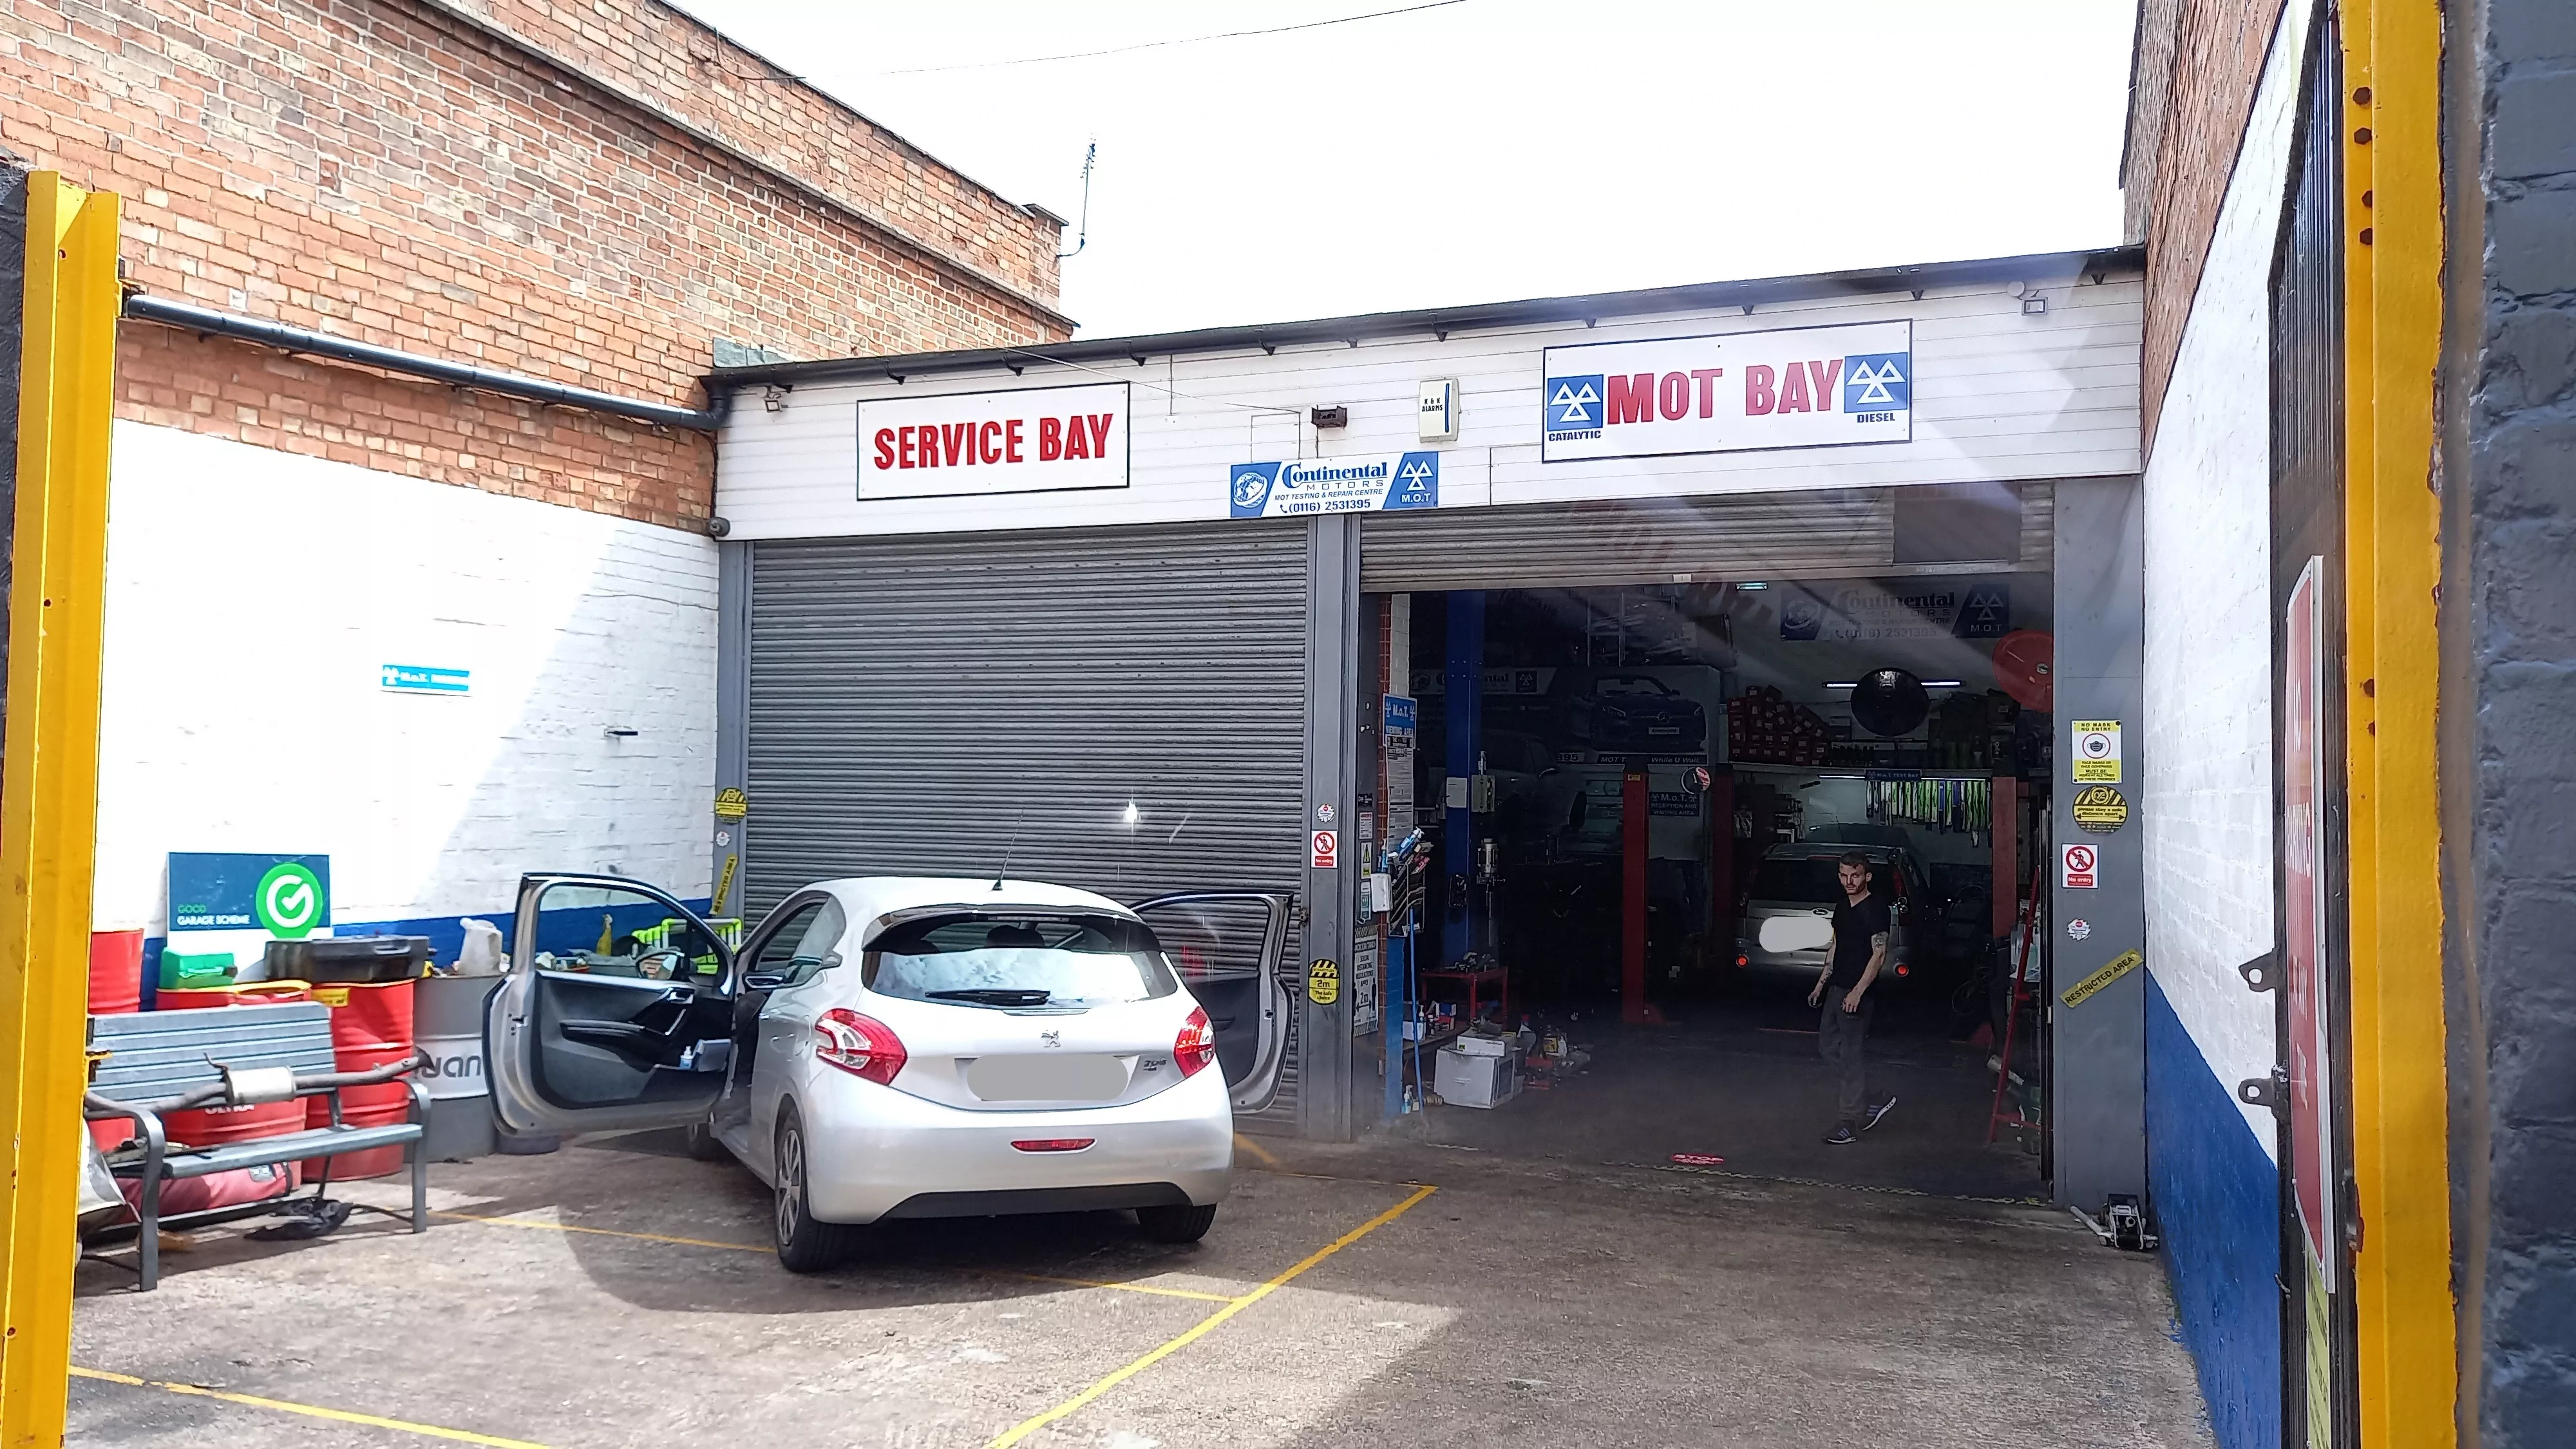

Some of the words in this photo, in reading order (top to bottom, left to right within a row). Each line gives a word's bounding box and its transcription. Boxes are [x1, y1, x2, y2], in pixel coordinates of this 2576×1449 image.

[1607, 368, 1723, 425] MOT
[1746, 359, 1843, 416] BAY
[1857, 412, 1895, 424] DIESEL
[874, 419, 1023, 470] SERVICE
[1040, 413, 1113, 461] BAY
[1548, 430, 1602, 442] CATALYTIC
[1282, 462, 1387, 488] Continental
[1307, 480, 1384, 491] MOTORS
[1355, 488, 1383, 497] CENTRE
[1401, 493, 1430, 502] M.O.T
[1289, 502, 1320, 514] (0116)
[1325, 499, 1370, 511] 2531395
[1837, 587, 1954, 615] Continental
[2286, 802, 2311, 878] PARKING
[178, 904, 207, 913] GOOD
[177, 914, 215, 925] GARAGE
[216, 914, 251, 925] SCHEME
[1317, 979, 1331, 988] 2m
[2065, 971, 2112, 1004] RESTRICTED
[2112, 956, 2134, 974] AREA
